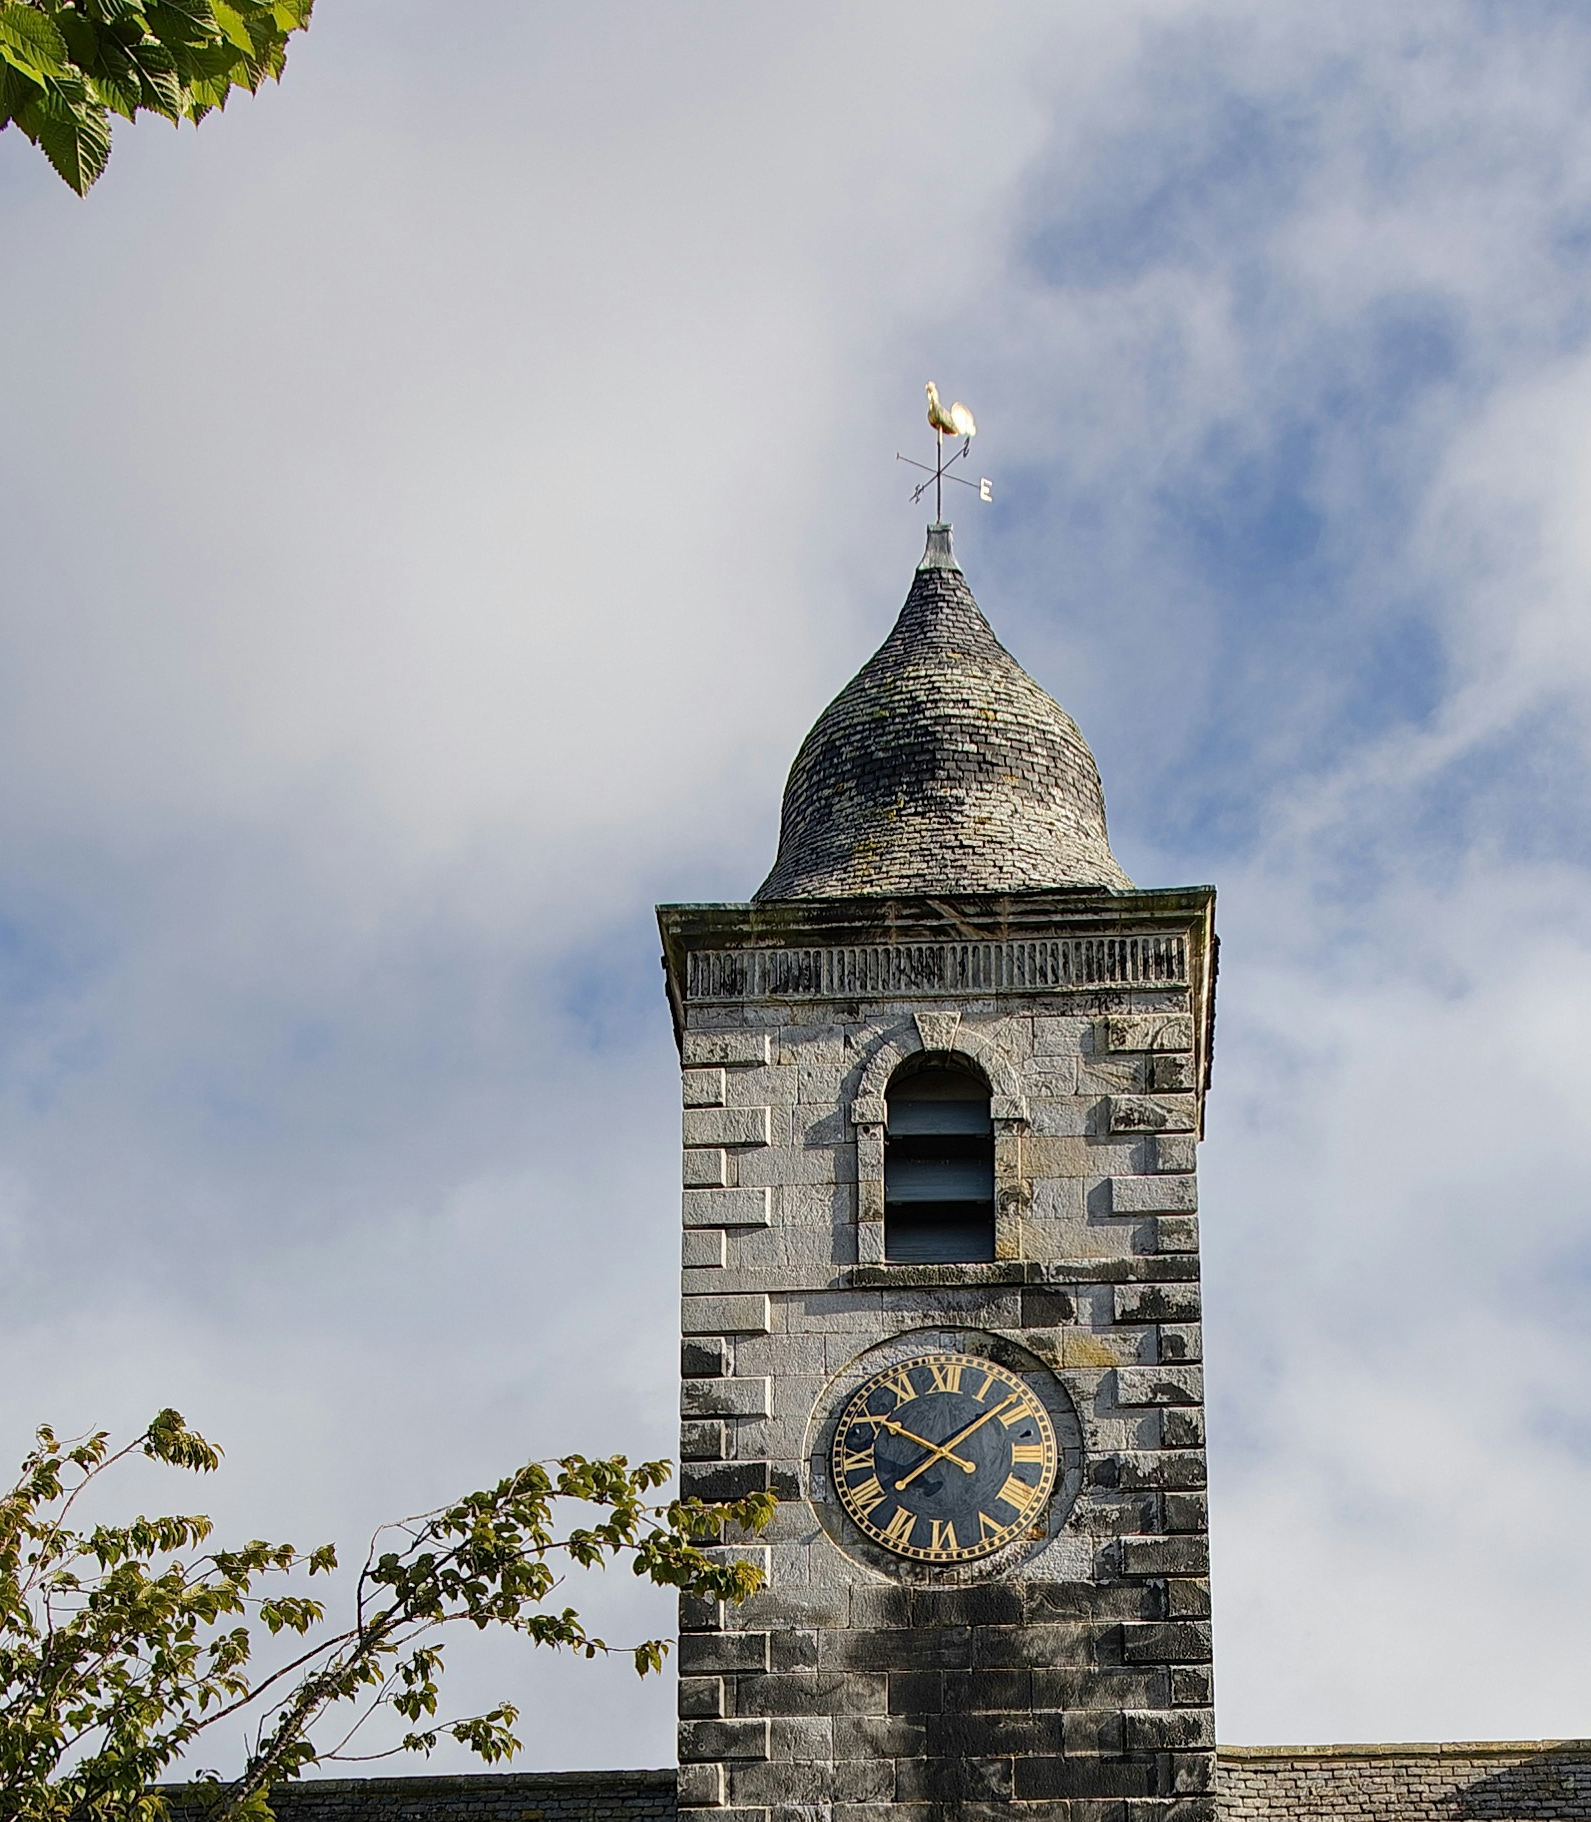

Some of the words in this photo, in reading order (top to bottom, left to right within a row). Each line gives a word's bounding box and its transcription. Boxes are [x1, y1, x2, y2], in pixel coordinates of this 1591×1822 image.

[980, 477, 993, 502] E
[881, 1372, 919, 1411] XI
[925, 1365, 966, 1395] XII
[972, 1373, 999, 1403] I
[850, 1400, 891, 1440] X
[997, 1400, 1035, 1430] II
[844, 1442, 875, 1475] IX
[1012, 1442, 1044, 1466] III
[849, 1473, 887, 1520] VIII
[995, 1472, 1039, 1515] IIII
[881, 1505, 918, 1545] VII
[926, 1519, 961, 1551] VI
[978, 1510, 1008, 1544] V
